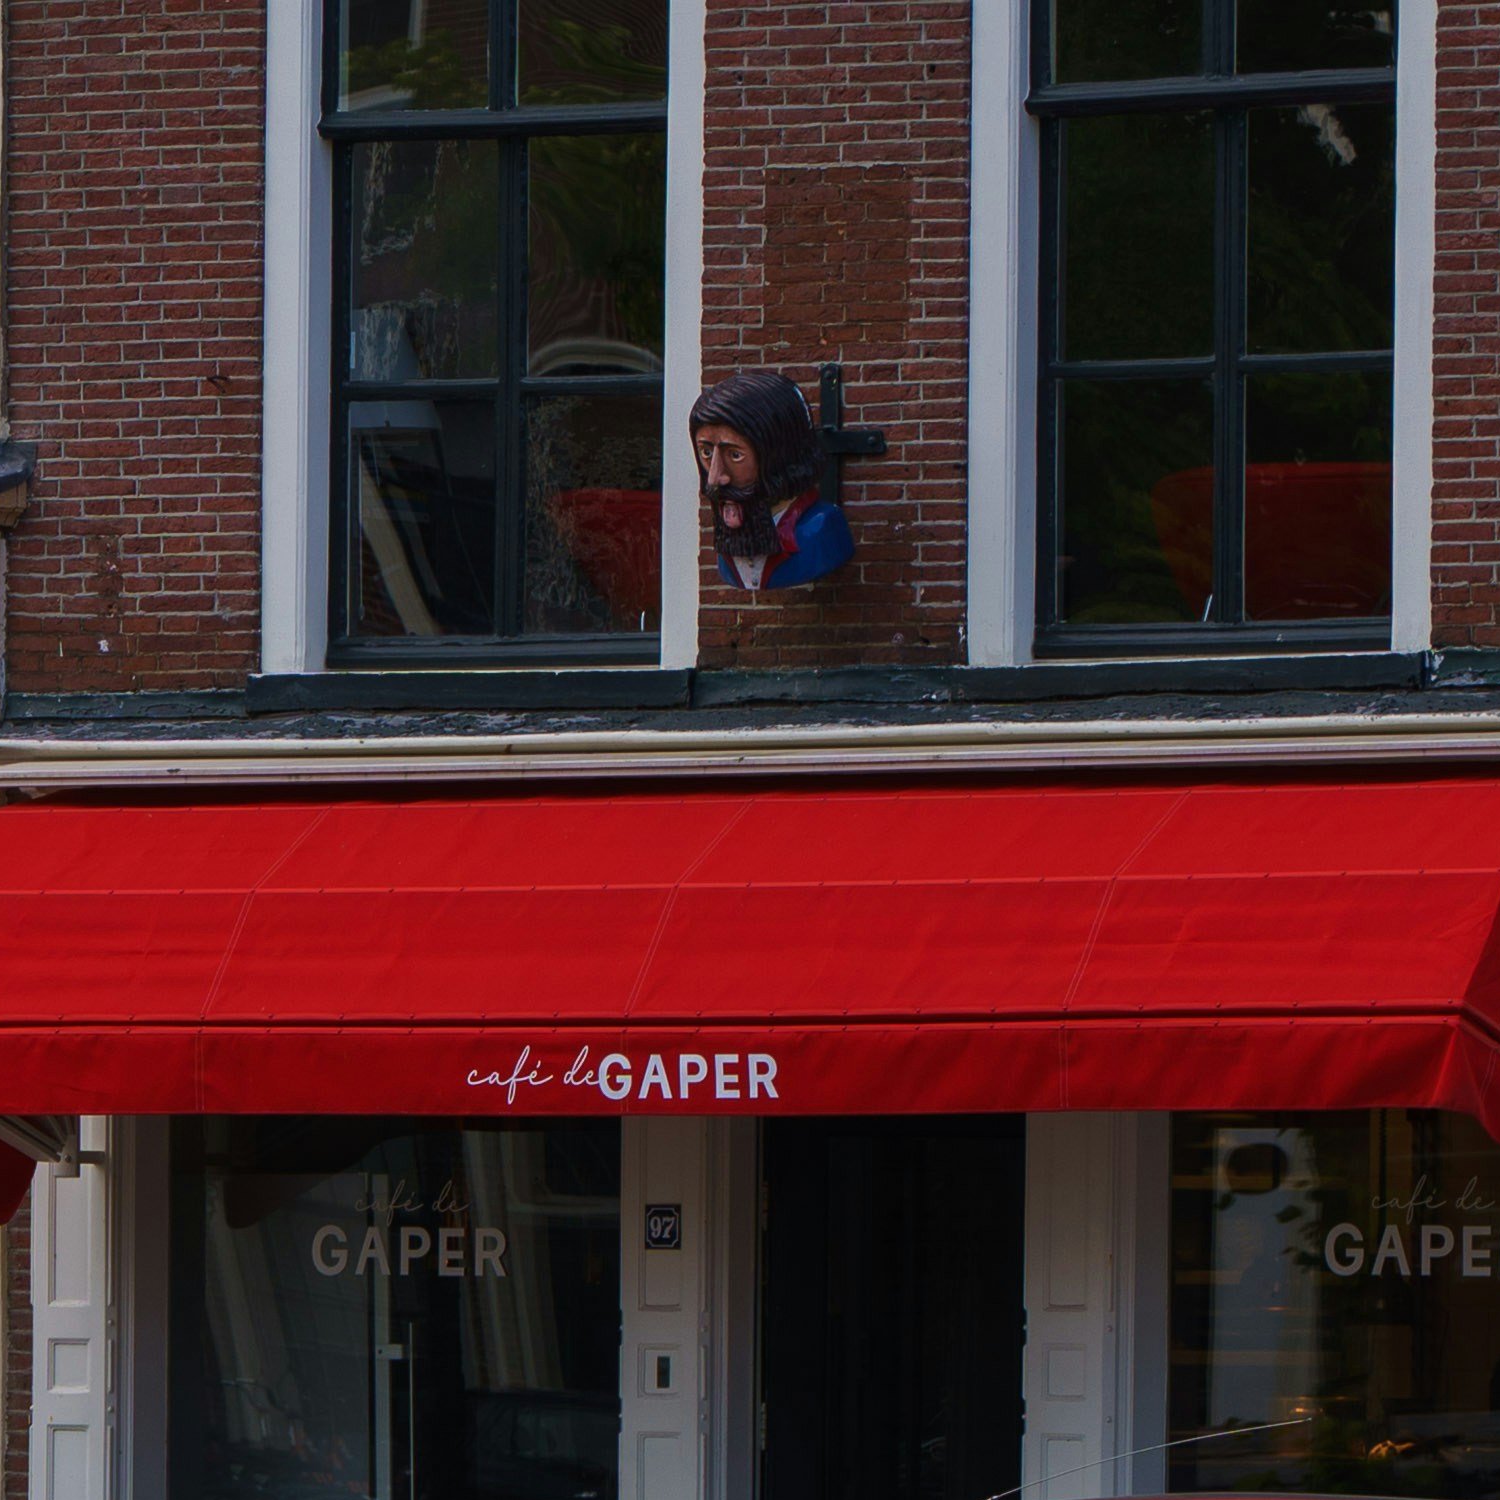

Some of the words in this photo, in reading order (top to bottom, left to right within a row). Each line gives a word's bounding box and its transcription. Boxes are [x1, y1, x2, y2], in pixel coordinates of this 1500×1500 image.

[467, 1045, 553, 1105] café
[563, 1045, 608, 1086] de
[599, 1053, 780, 1100] GAPER
[354, 1179, 425, 1226] café
[432, 1179, 471, 1213] de
[1371, 1174, 1447, 1225] café
[1455, 1175, 1496, 1211] de
[311, 1224, 508, 1277] GAPER
[650, 1216, 676, 1239] 97
